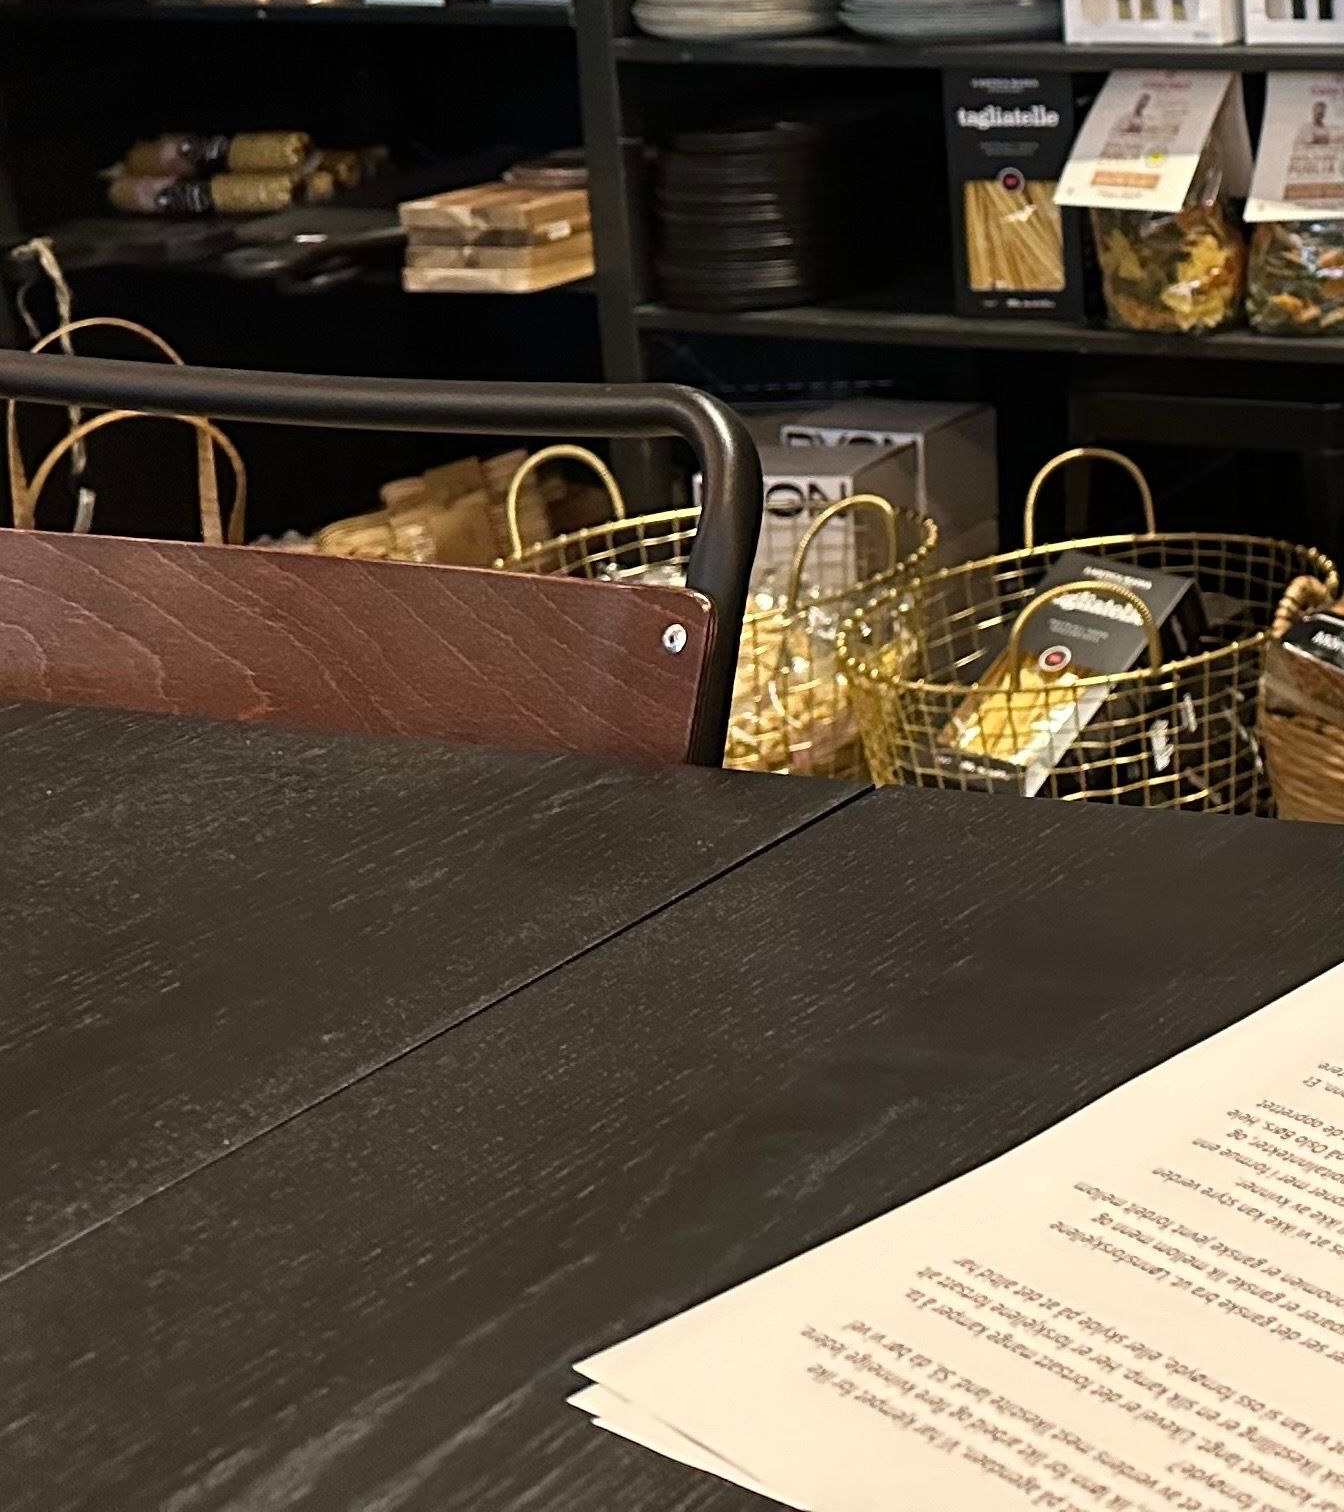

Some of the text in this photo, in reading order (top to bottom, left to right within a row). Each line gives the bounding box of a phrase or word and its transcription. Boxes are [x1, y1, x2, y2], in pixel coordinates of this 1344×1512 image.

[956, 101, 1061, 131] tagliatelle
[1225, 1109, 1260, 1125] Hele
[1254, 1098, 1325, 1128] opprettet
[1191, 1139, 1220, 1151] enn
[1292, 1136, 1328, 1153] Oslo
[1217, 1148, 1271, 1175] formue
[1150, 1168, 1201, 1190] verden
[1276, 1174, 1309, 1189] mer
[1071, 1183, 1127, 1207] mellom
[1198, 1186, 1240, 1207] styre
[1121, 1203, 1173, 1229] fordelt
[1235, 1204, 1265, 1220] kan
[1308, 1210, 1342, 1228] ikke
[1110, 1223, 1153, 1244] menn
[1169, 1223, 1216, 1245] jevnt
[1262, 1216, 1297, 1233] ikke
[1047, 1220, 1172, 1280] Lønnsforskjellene
[1150, 1242, 1208, 1271] mellom
[1208, 1241, 1267, 1269] ganske
[950, 1257, 980, 1274] har
[1205, 1267, 1228, 1281] lik
[973, 1268, 1018, 1290] alltid
[1224, 1275, 1285, 1304] ganske
[1011, 1286, 1043, 1302] det
[1189, 1286, 1220, 1304] bra
[1216, 1298, 1277, 1328] ganske
[1075, 1316, 1129, 1344] skylde
[1268, 1323, 1301, 1340] det
[1121, 1342, 1162, 1361] eller
[1298, 1338, 1328, 1352] ser
[1234, 1395, 1265, 1412] oss
[1278, 1417, 1312, 1438] kan
